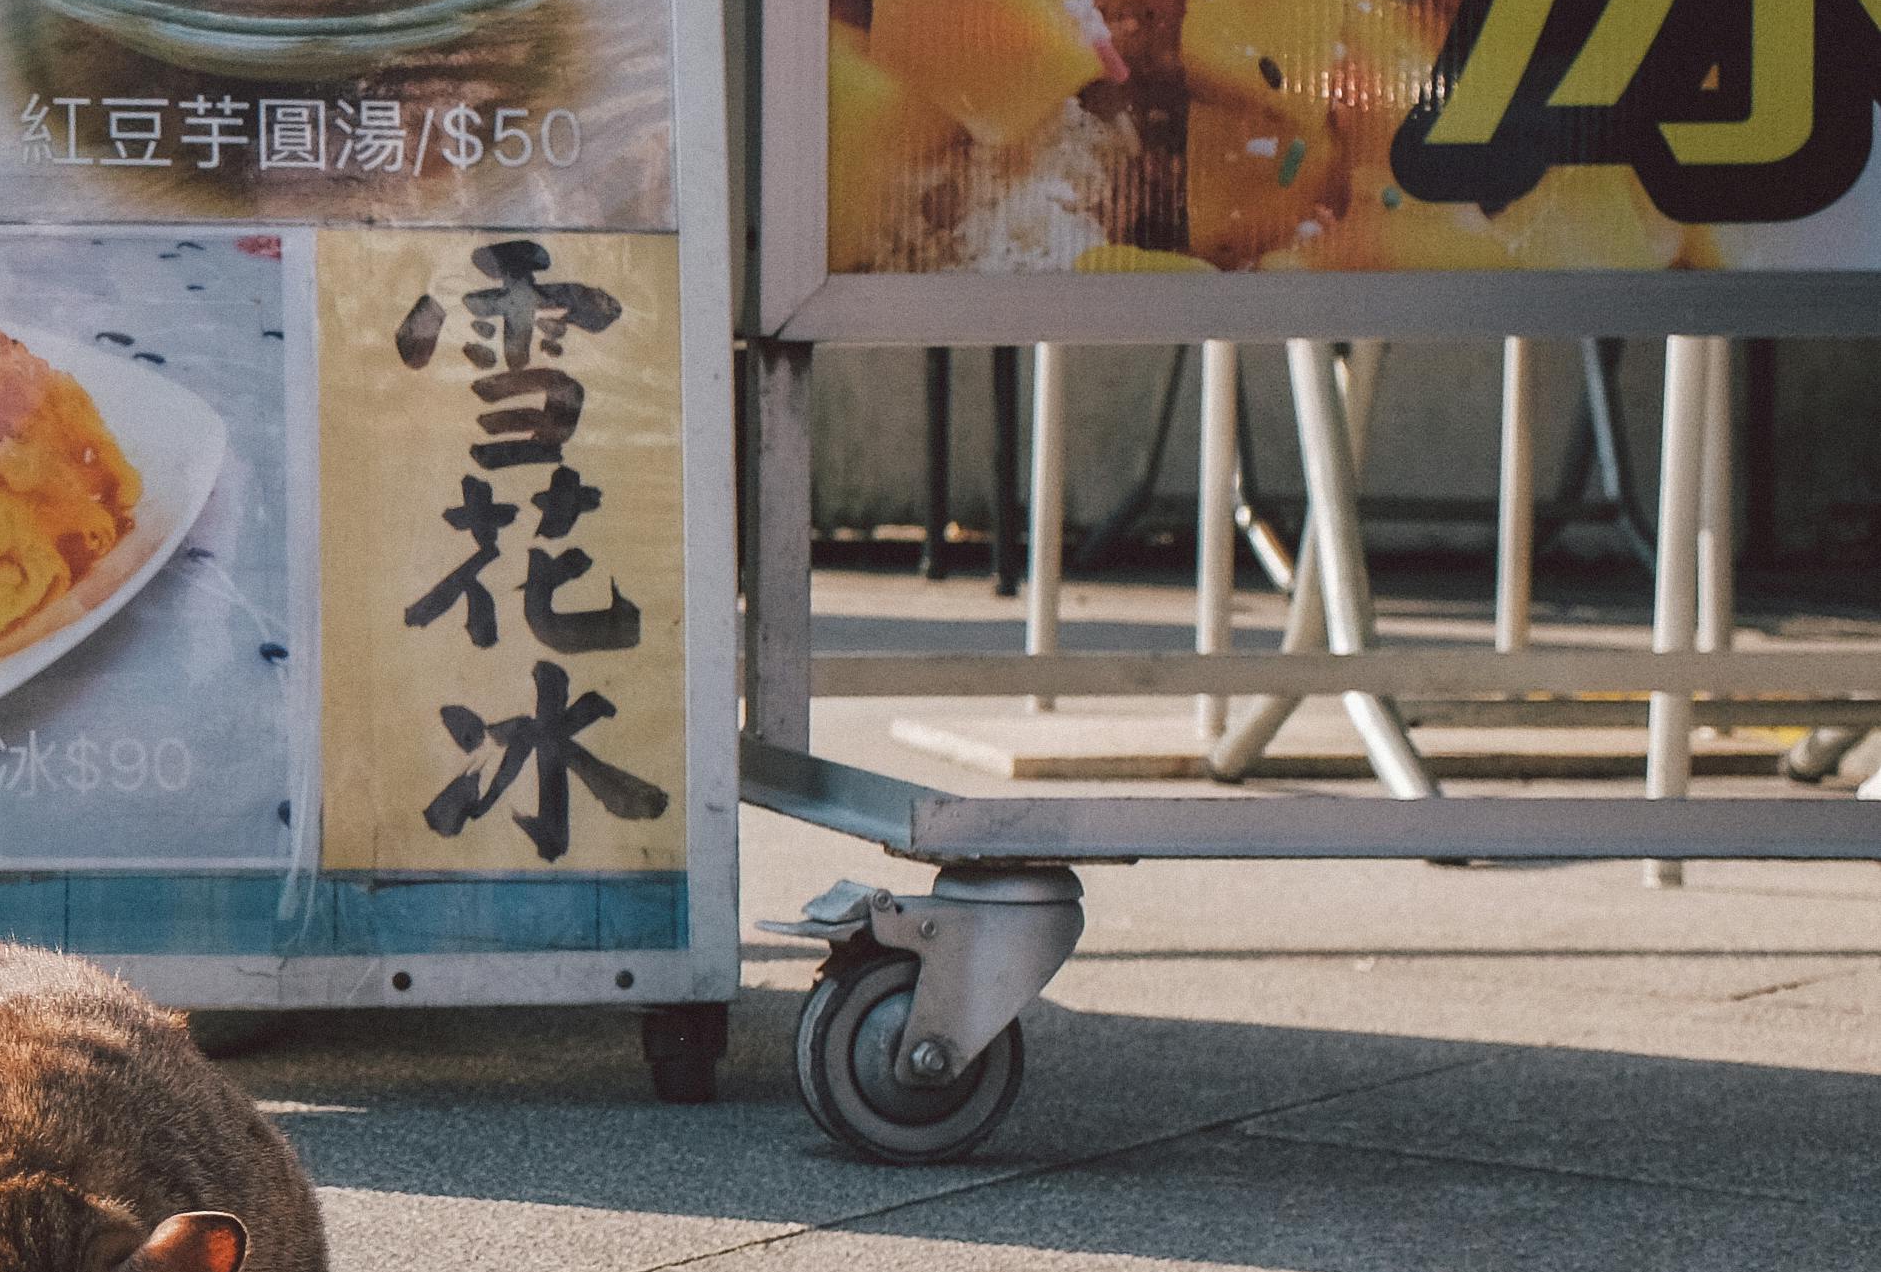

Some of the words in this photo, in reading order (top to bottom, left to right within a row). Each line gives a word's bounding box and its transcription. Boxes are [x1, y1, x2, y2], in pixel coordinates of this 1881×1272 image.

[18, 92, 583, 179] 紅豆芋圓湯/$50
[394, 238, 670, 864] 雪花冰
